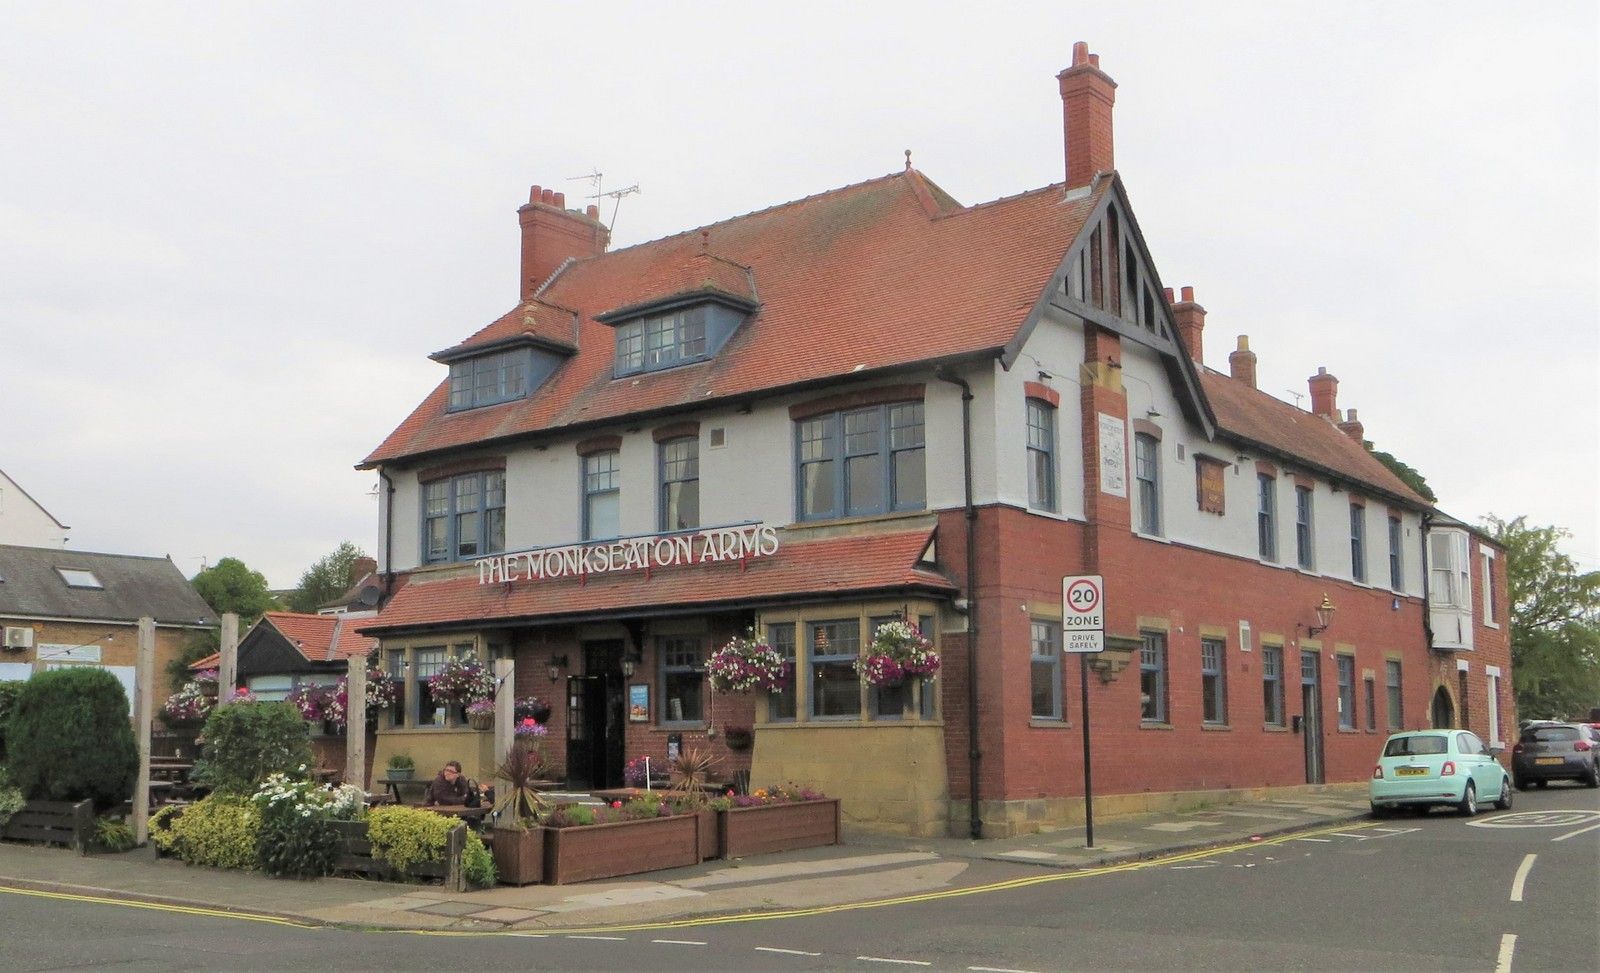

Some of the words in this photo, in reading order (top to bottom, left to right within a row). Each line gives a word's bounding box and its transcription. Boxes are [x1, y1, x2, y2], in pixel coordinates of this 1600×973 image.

[475, 557, 519, 585] THE
[526, 536, 694, 580] MONKSEATON
[700, 527, 779, 562] ARMS
[1073, 589, 1095, 603] 20
[1067, 616, 1100, 626] ZONE
